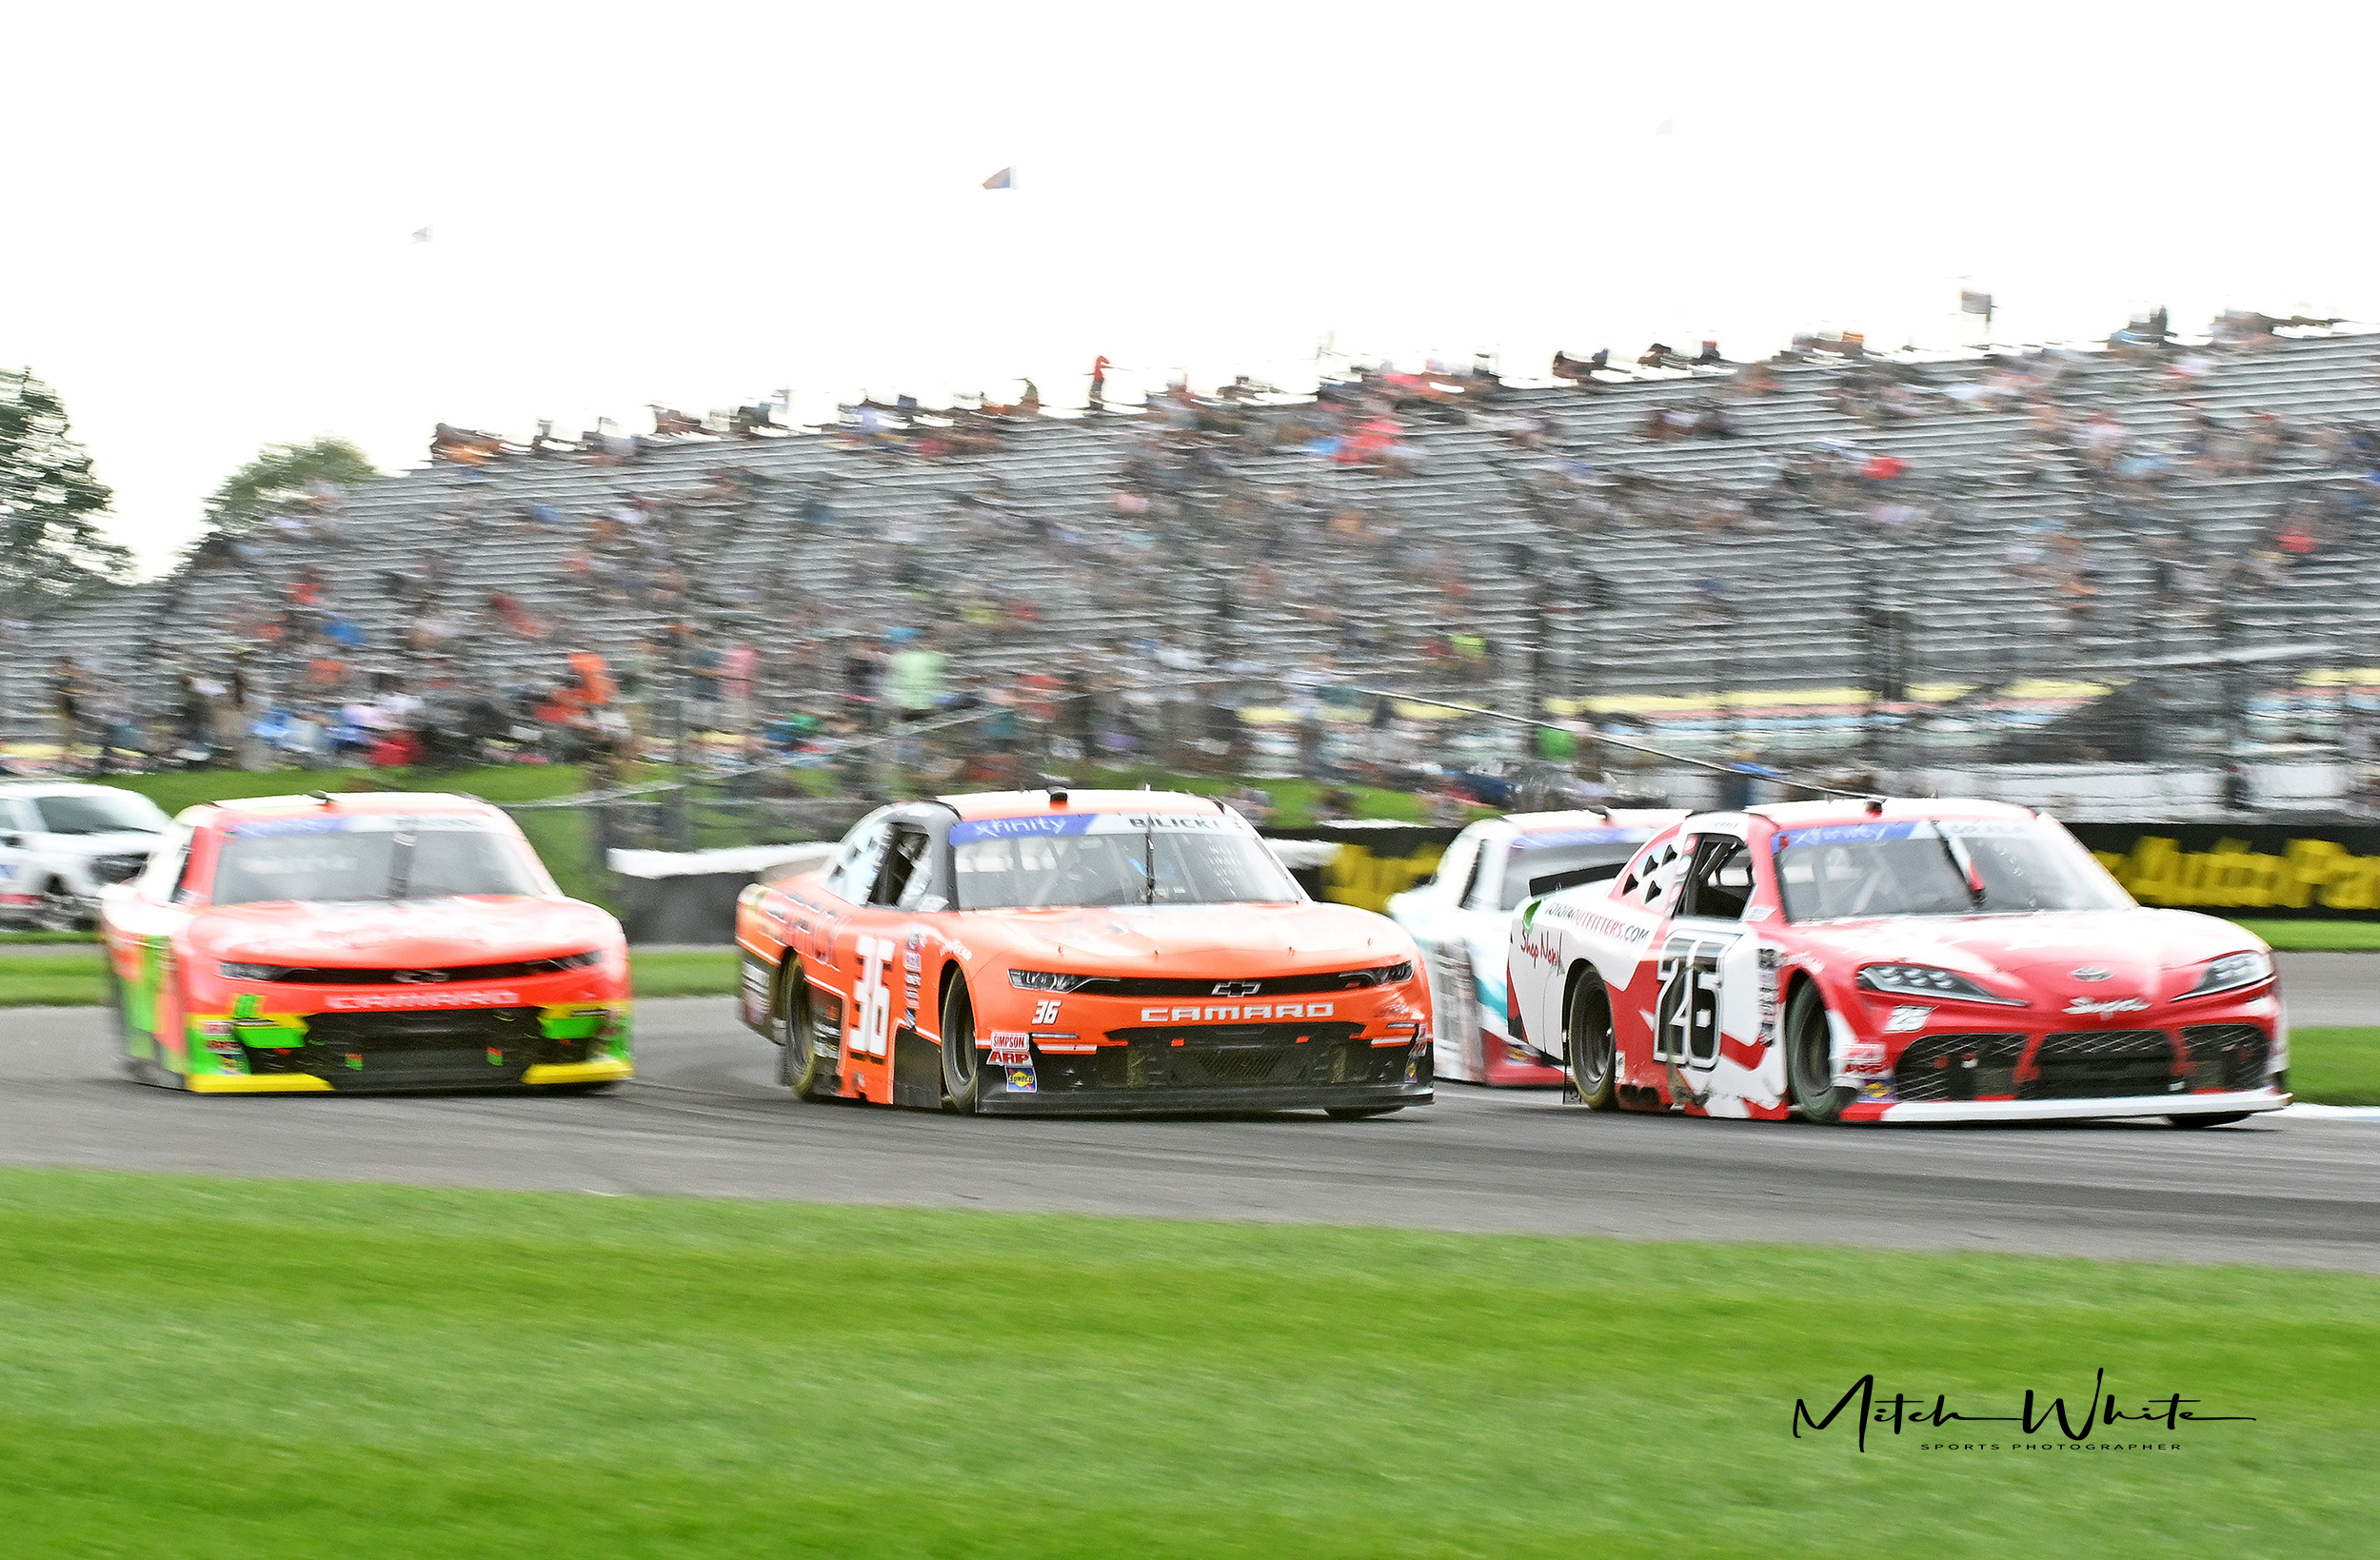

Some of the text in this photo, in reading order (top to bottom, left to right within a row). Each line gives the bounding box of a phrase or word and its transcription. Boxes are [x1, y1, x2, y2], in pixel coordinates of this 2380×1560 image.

[974, 816, 1067, 838] xfinity
[1130, 816, 1221, 830] BILICKI
[849, 935, 895, 1057] 36
[1654, 932, 1736, 1070] 26
[1031, 999, 1062, 1025] 36
[1140, 1001, 1334, 1022] CAMARO
[993, 1036, 1025, 1049] SIMPSON
[989, 1051, 1029, 1063] ARP
